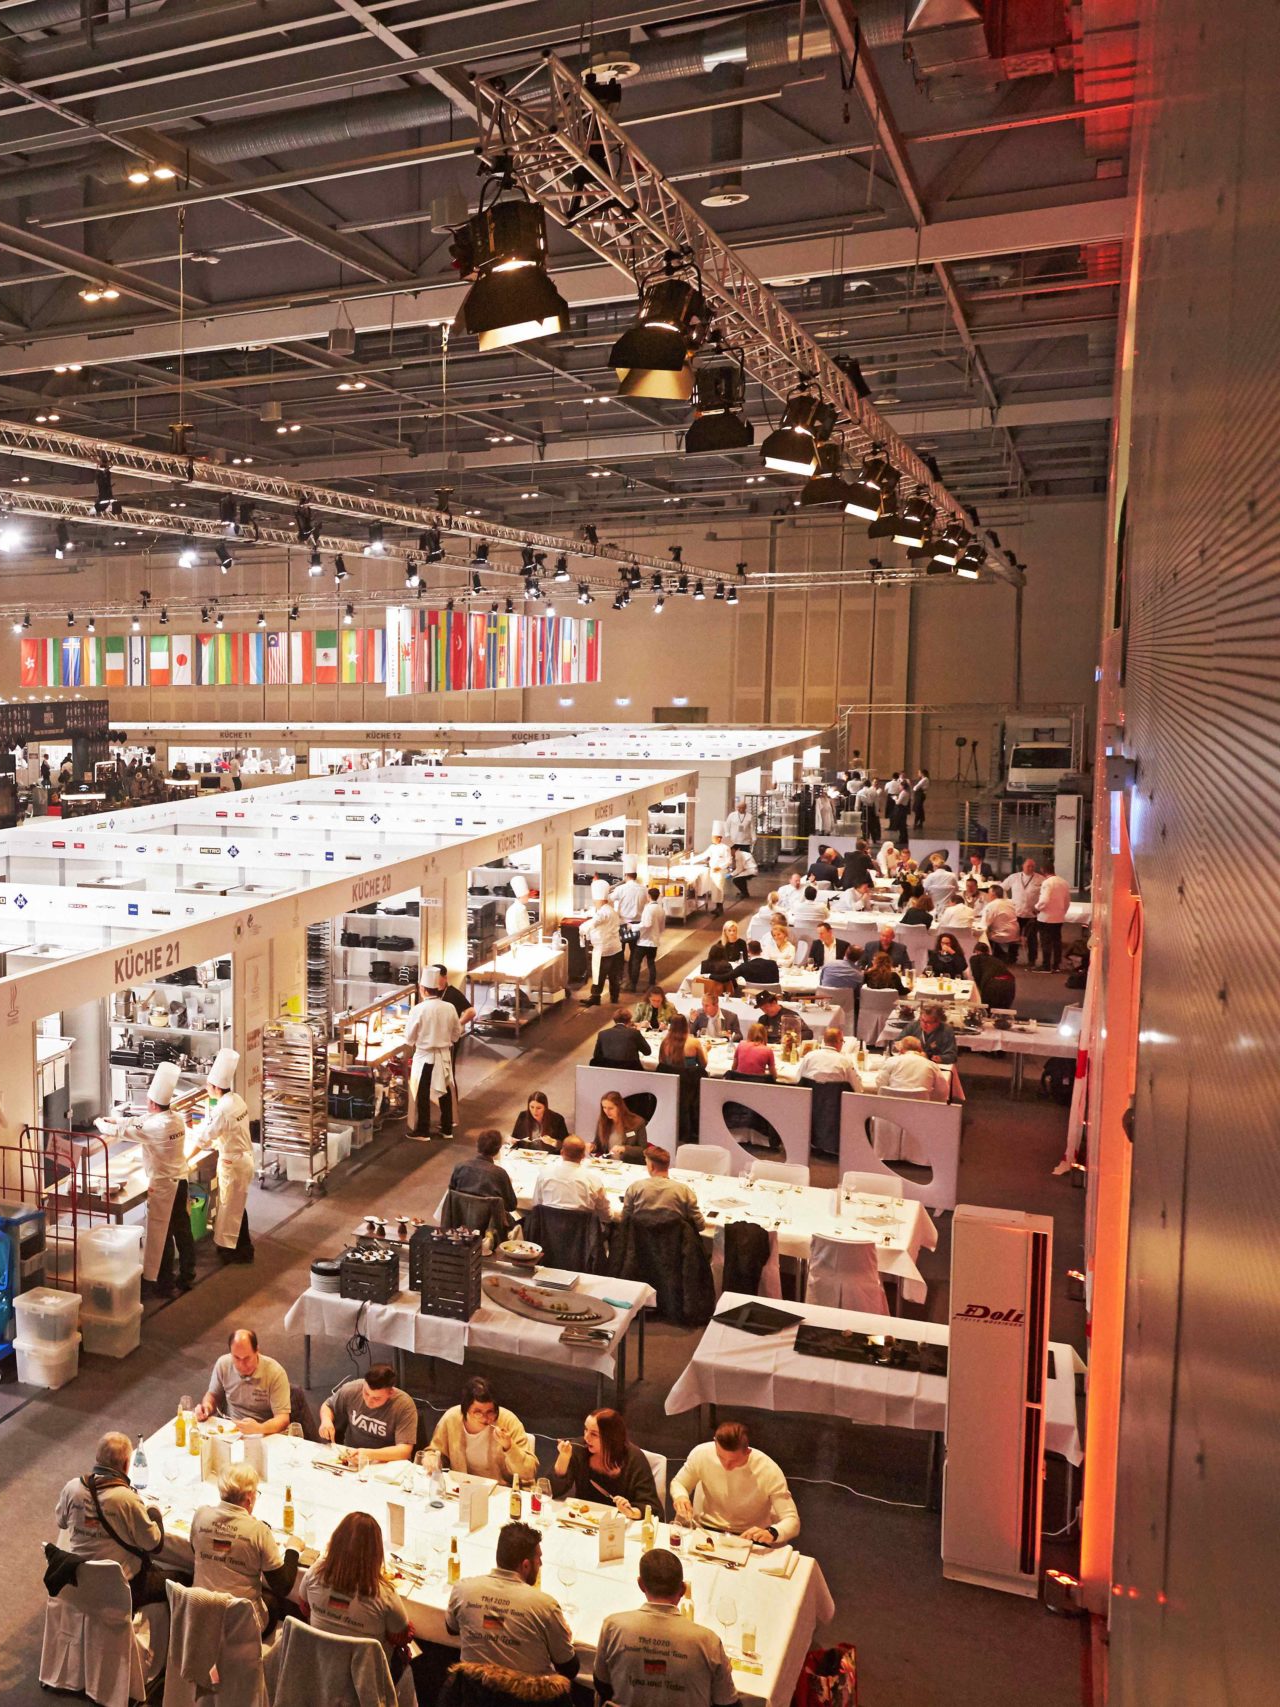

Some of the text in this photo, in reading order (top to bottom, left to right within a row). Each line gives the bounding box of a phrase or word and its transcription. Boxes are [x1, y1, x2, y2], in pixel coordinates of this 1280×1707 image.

[220, 730, 244, 738] KÜCHE
[366, 730, 392, 739] KÜCHE
[512, 732, 538, 740] KÜCHE
[498, 833, 517, 853] KÜCHE
[352, 872, 393, 903] KÜCHE 20
[114, 941, 181, 982] KÜCHE 21
[351, 1410, 387, 1437] VANS
